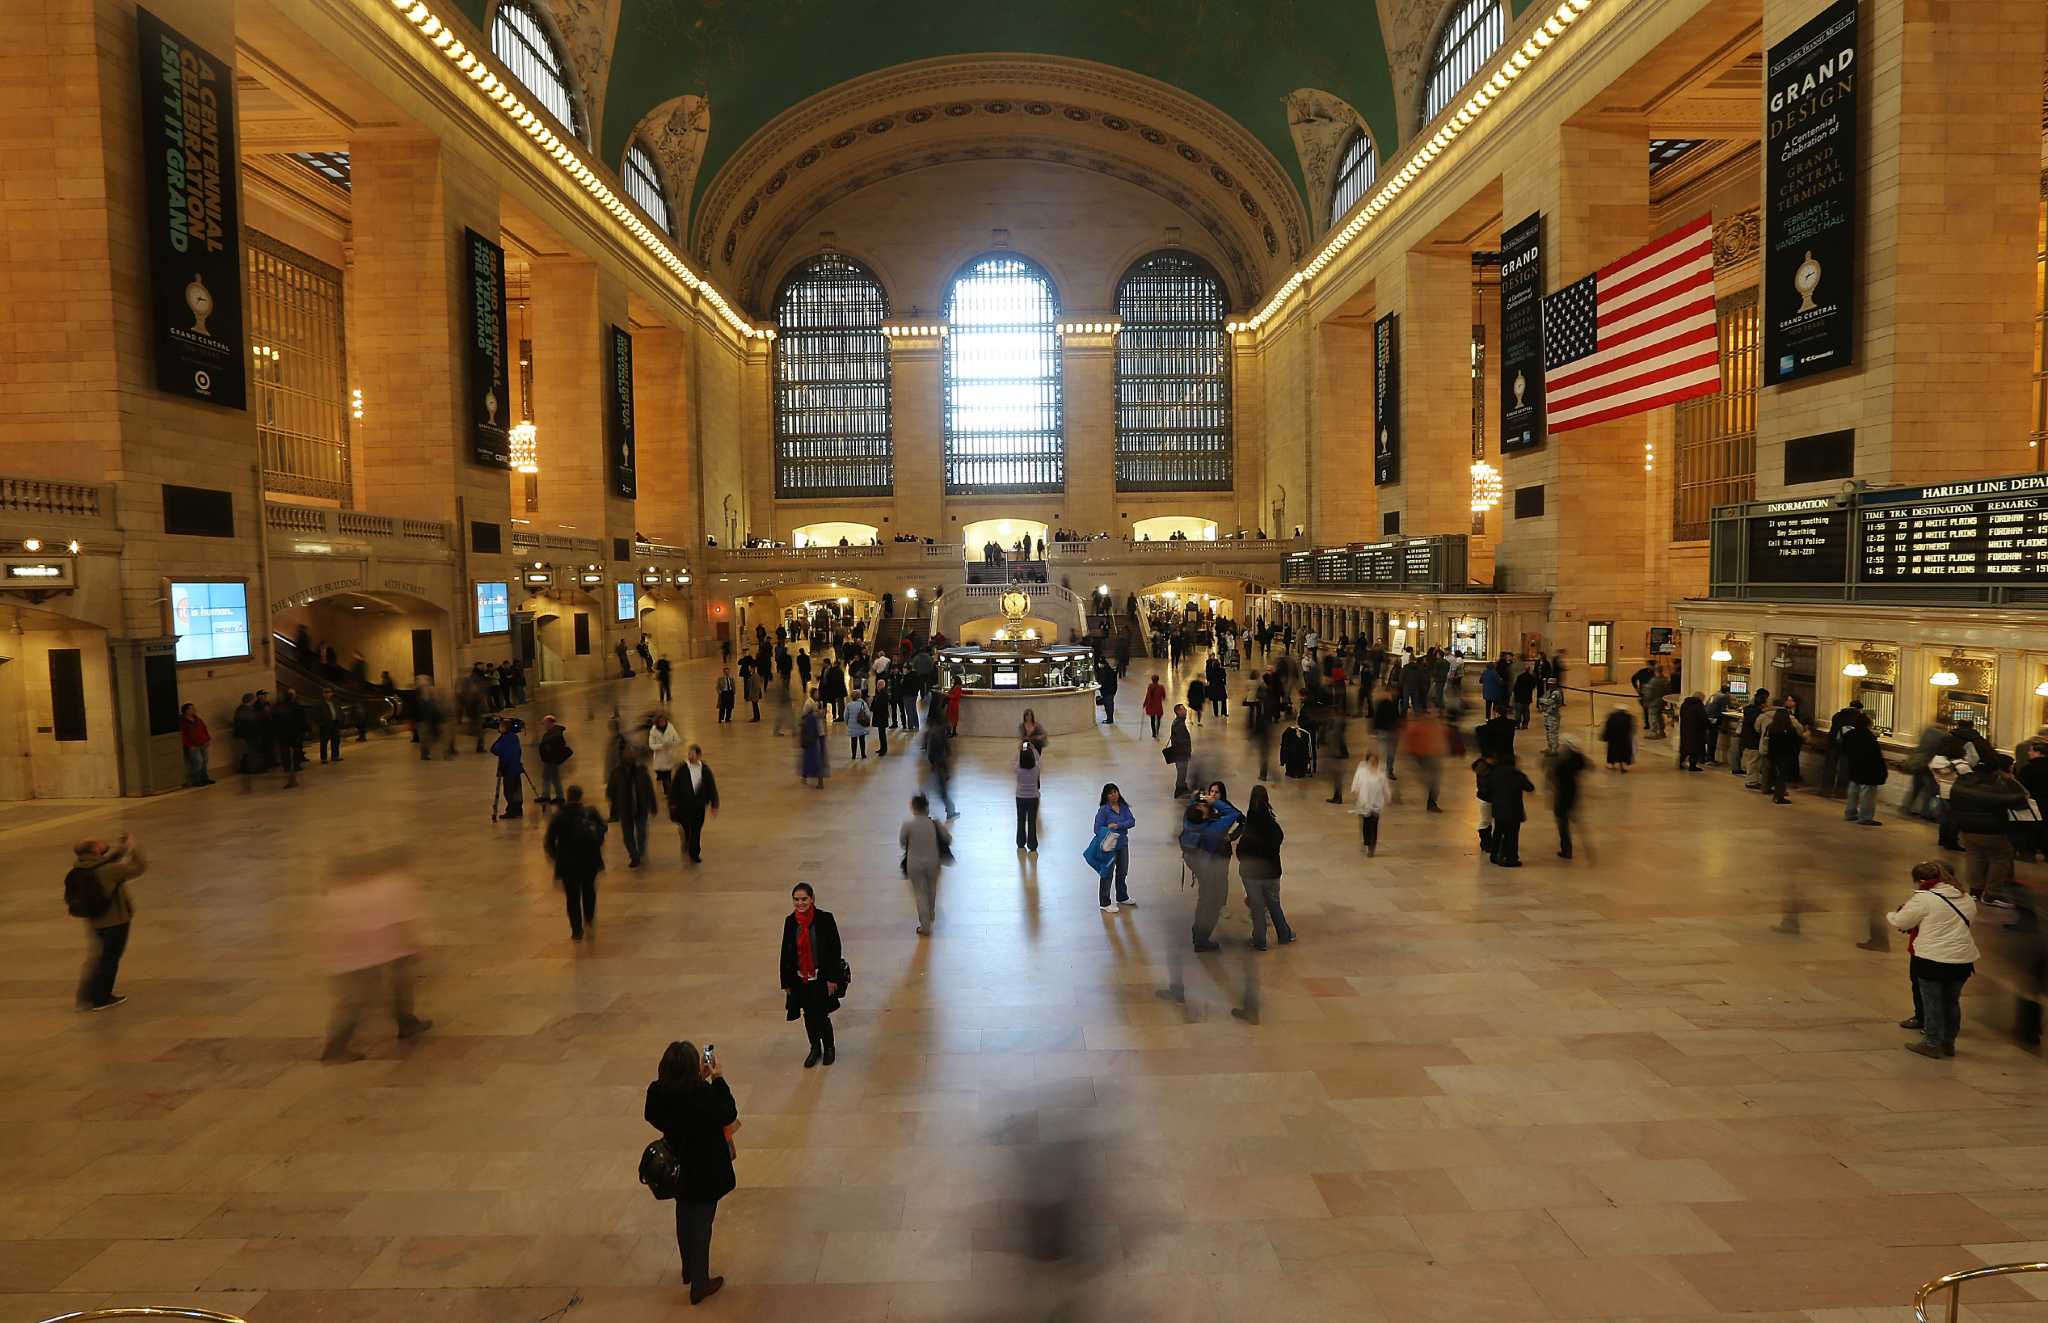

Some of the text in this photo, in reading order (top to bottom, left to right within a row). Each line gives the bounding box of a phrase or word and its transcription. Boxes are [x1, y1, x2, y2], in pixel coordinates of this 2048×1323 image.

[1769, 47, 1854, 113] GRAND
[1769, 73, 1854, 142] DESIGN
[160, 33, 189, 253] ISN'T IT GRAND
[1781, 121, 1840, 162] Celebration of
[1784, 113, 1837, 151] A Centennial
[180, 48, 206, 241] CELEBRATION
[200, 58, 224, 253] A CENTENNIAL
[1786, 146, 1834, 179] GRAND
[1779, 158, 1841, 197] CENTRAL
[1776, 171, 1846, 213] TERMINAL
[1502, 246, 1538, 277] GRAND
[1502, 264, 1538, 293] DESIGN
[1780, 315, 1802, 328] GRAND
[1803, 304, 1838, 320] CENTRAL
[197, 336, 231, 352] CENTRAL
[1922, 484, 1974, 499] HARLEM
[1977, 480, 2007, 493] LINE
[1768, 499, 1829, 512] INFORMATION
[1864, 498, 2039, 520] TIME TRK DESTINATION REMARKS
[1788, 528, 1816, 536] Something
[1800, 516, 1829, 525] something
[1925, 518, 1947, 527] WHITE
[1950, 516, 1977, 526] PLAINS
[1989, 513, 2024, 523] FORDHAM
[1805, 537, 1826, 545] Police
[1866, 533, 1885, 542] 12:25
[1925, 530, 1947, 539] WHITE
[1949, 528, 1977, 538] PLAINS
[1988, 526, 2023, 536] FORDHAM
[1912, 542, 1950, 551] SOUTHEAST
[1988, 540, 2013, 548] WHITE
[2016, 538, 2047, 547] PLAINS
[1866, 556, 1884, 564] 12:55
[1924, 554, 1946, 562] WHITE
[1948, 553, 1975, 562] PLAINS
[1987, 552, 2022, 561] FORDHAM
[1923, 565, 1946, 574] WHITE
[1948, 565, 1975, 574] PLAINS
[1987, 564, 2021, 573] MELROSE
